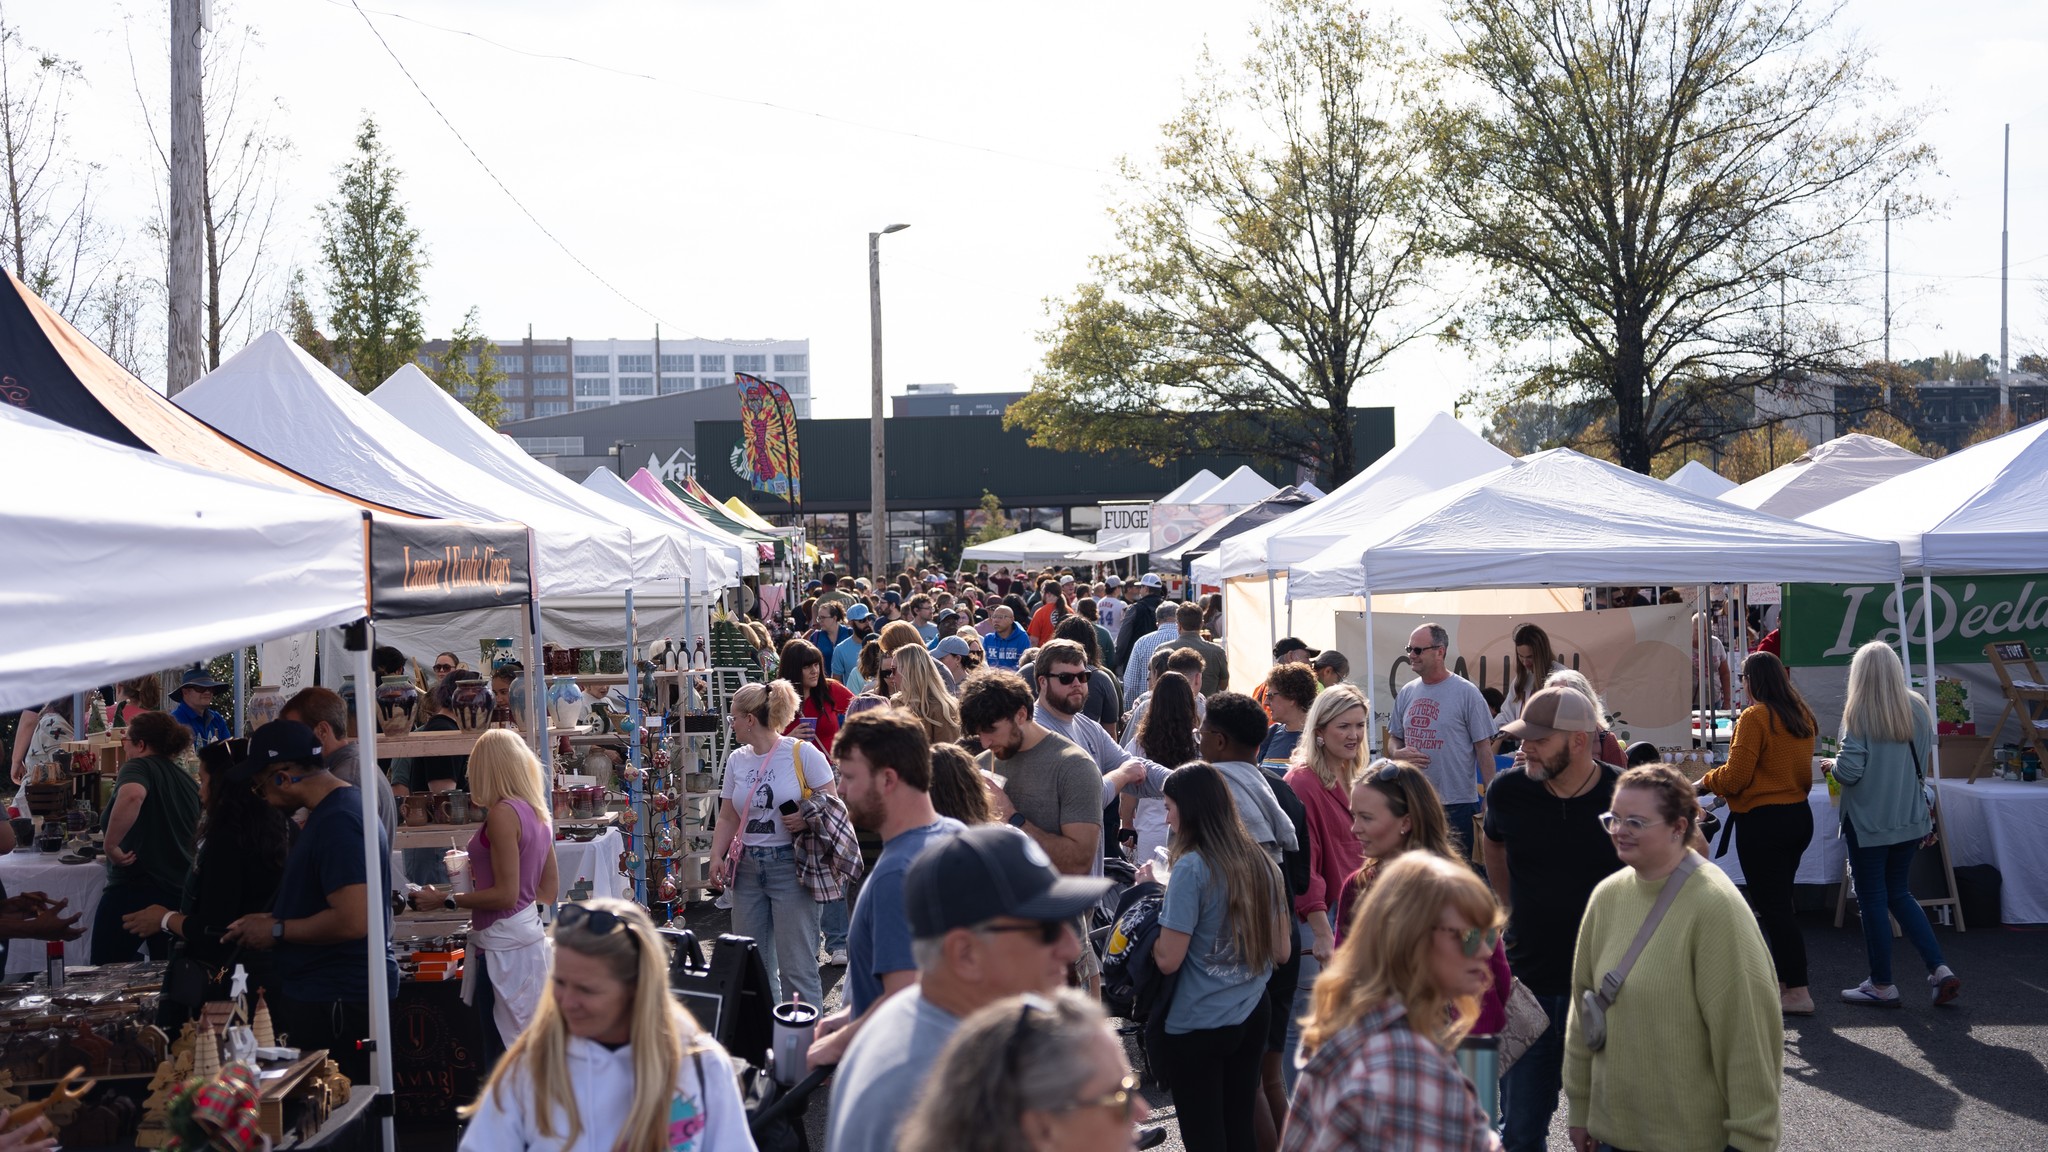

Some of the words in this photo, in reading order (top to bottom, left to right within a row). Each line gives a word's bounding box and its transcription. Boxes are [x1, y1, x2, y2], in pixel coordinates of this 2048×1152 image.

[1104, 510, 1149, 529] FUDGE
[403, 546, 442, 592] Lamar
[452, 545, 482, 588] Exotic
[482, 545, 511, 595] Cigars
[1823, 587, 1875, 658] I
[392, 1070, 449, 1087] AMAR
